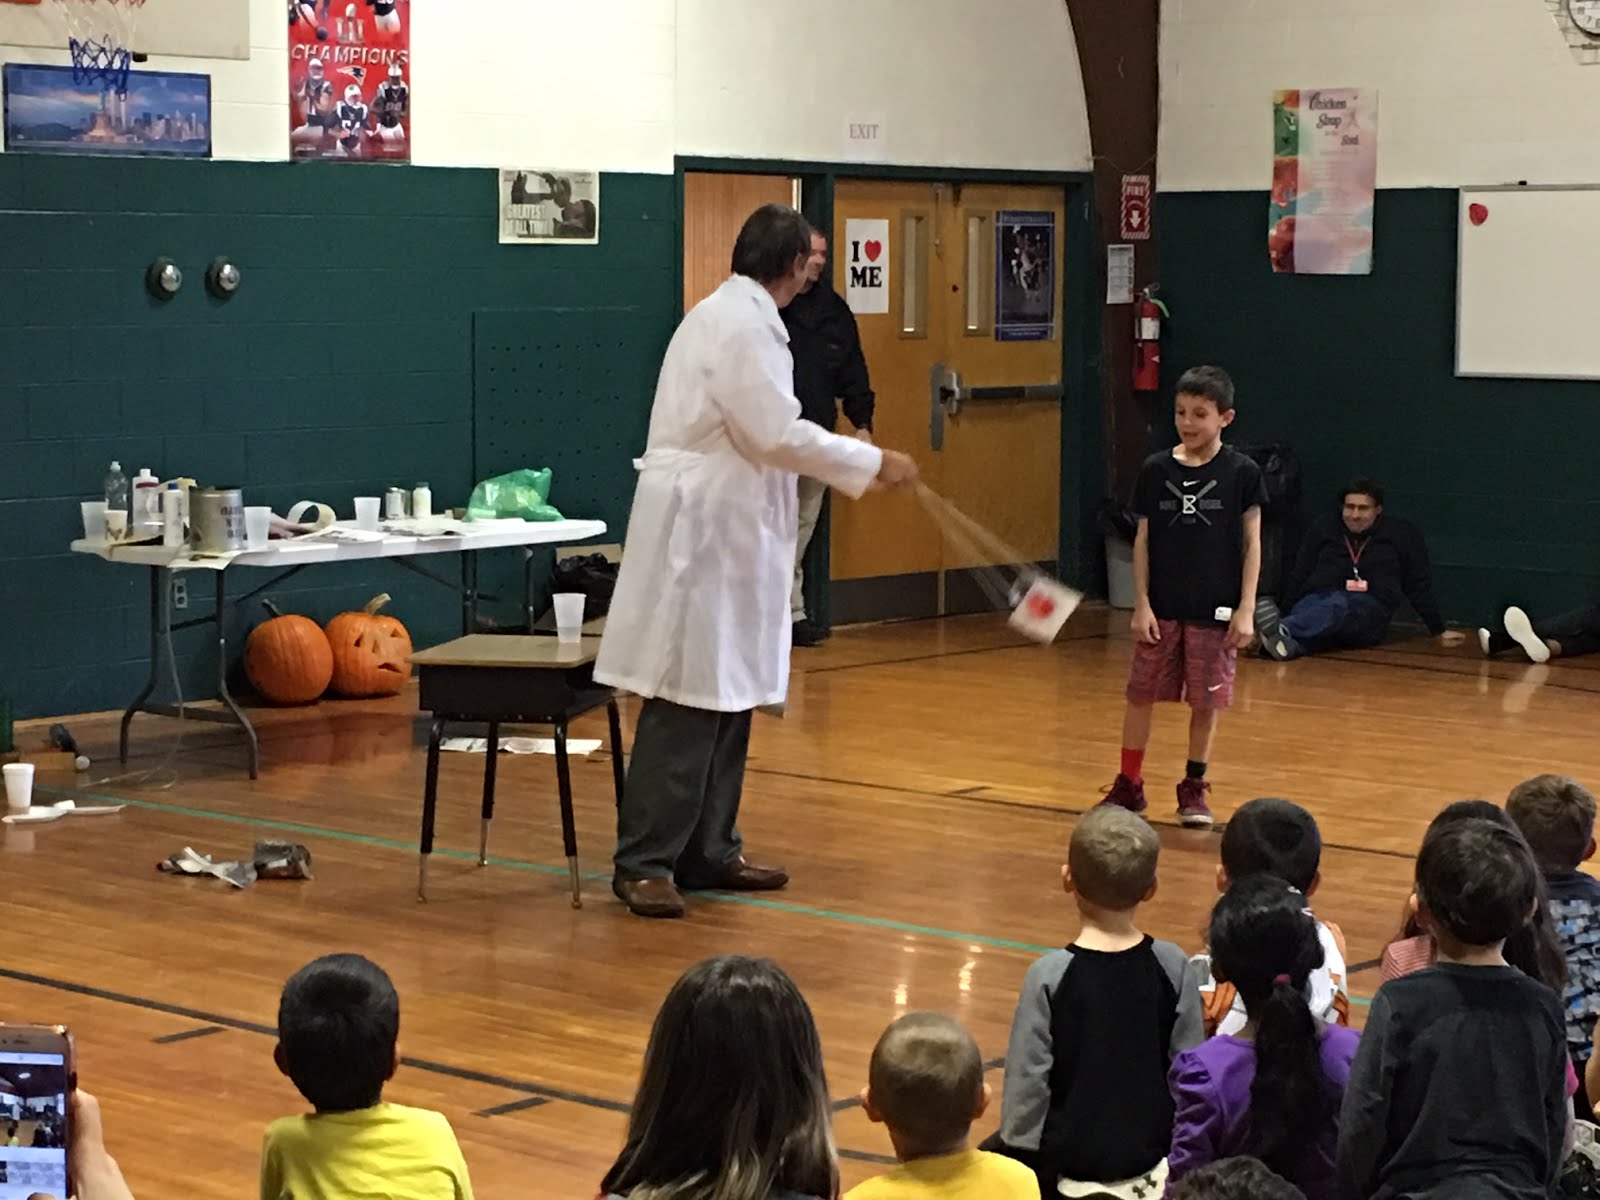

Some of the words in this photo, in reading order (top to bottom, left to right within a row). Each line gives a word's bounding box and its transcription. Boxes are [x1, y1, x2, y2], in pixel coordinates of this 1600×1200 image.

[291, 44, 409, 65] CHAMPIONS
[849, 123, 879, 139] EXIT
[1126, 184, 1144, 197] FIRE
[852, 240, 860, 262] I
[850, 266, 882, 287] ME
[1182, 494, 1197, 514] B
